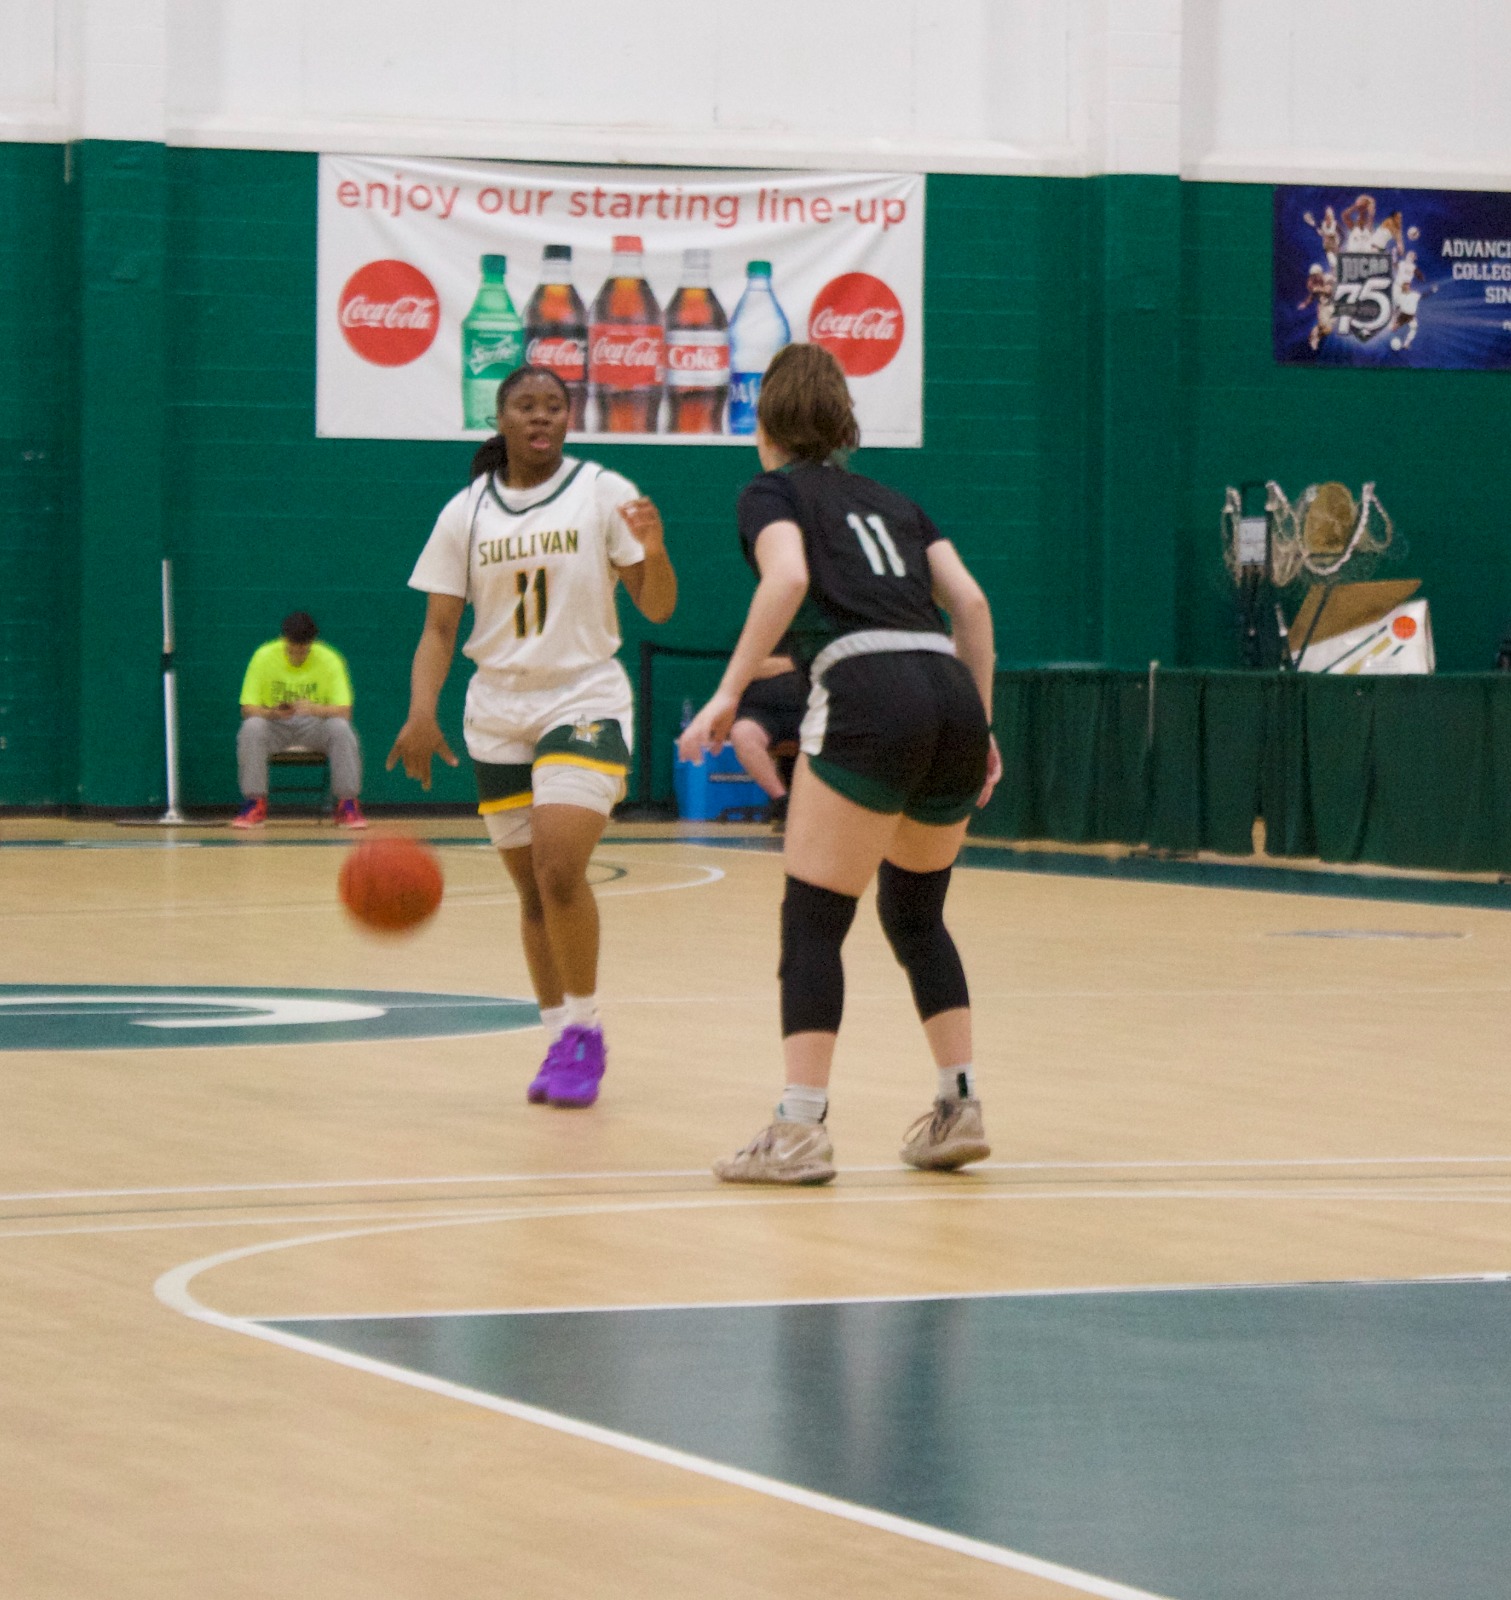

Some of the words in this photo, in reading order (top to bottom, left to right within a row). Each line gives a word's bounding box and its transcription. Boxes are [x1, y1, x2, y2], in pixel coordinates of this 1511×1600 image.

[336, 174, 460, 219] enjoy
[477, 186, 553, 215] our
[568, 186, 739, 228] starting
[757, 188, 906, 231] line-up
[339, 295, 436, 329] Coca-Cola
[810, 308, 903, 340] Coca-Cola
[1333, 277, 1391, 334] 75
[669, 347, 720, 370] Coke
[478, 529, 579, 567] SULLIVAN
[846, 511, 907, 578] 11
[513, 566, 548, 639] 11
